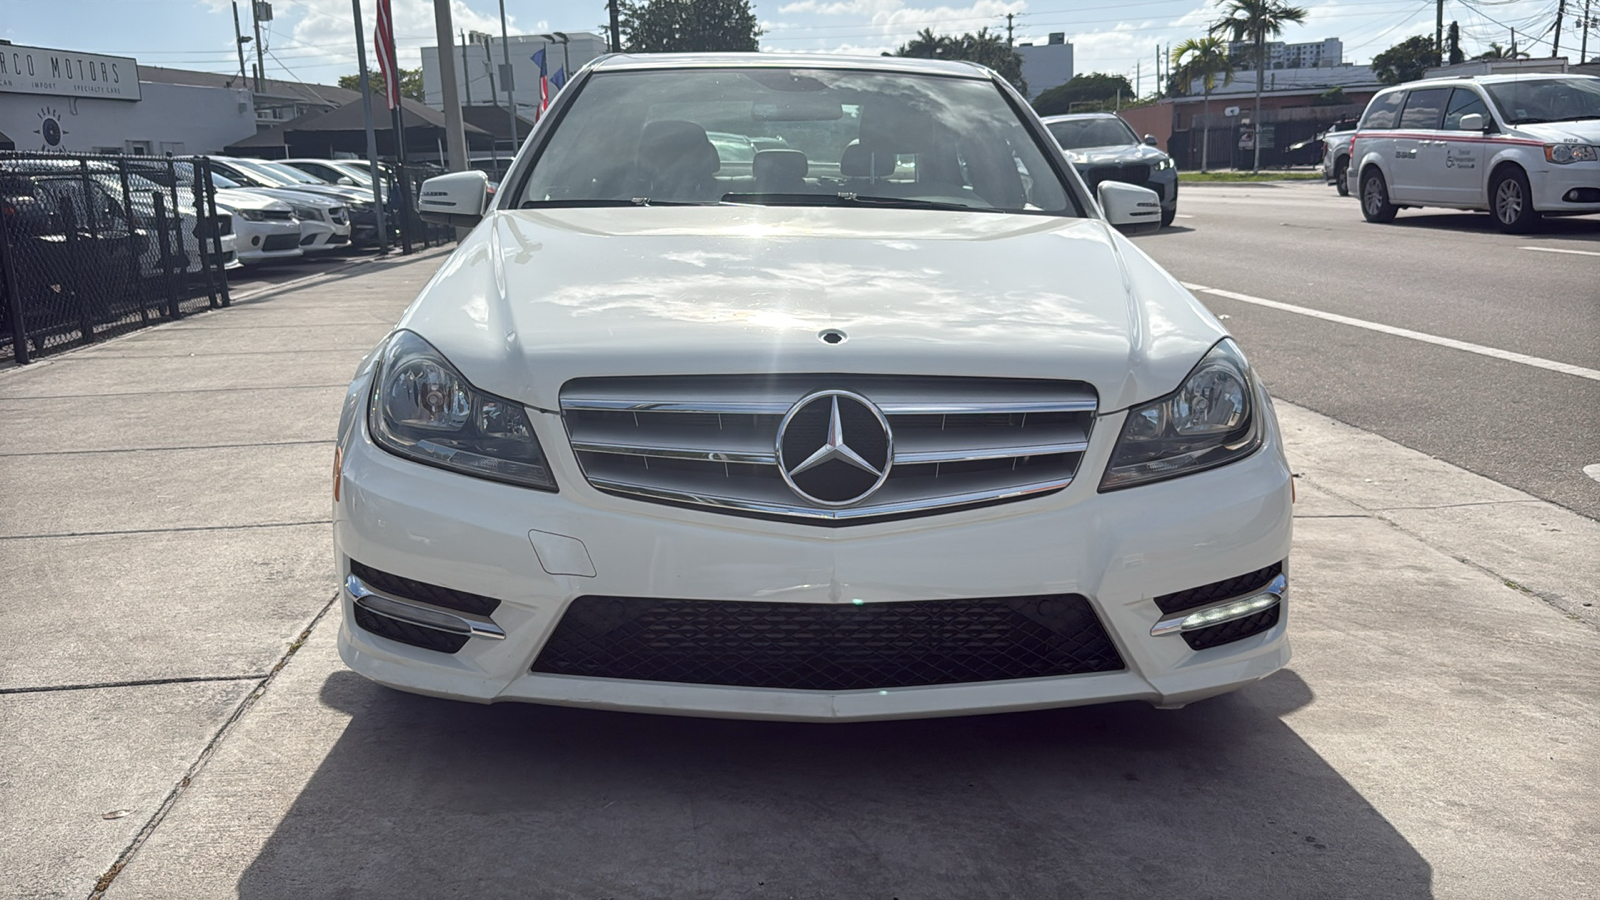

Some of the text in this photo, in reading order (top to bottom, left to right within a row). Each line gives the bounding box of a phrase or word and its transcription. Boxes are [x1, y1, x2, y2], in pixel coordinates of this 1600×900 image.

[50, 57, 120, 84] MOTORS
[31, 82, 57, 90] IMPORT
[73, 85, 105, 94] SPECIALTY
[106, 87, 122, 95] CARS
